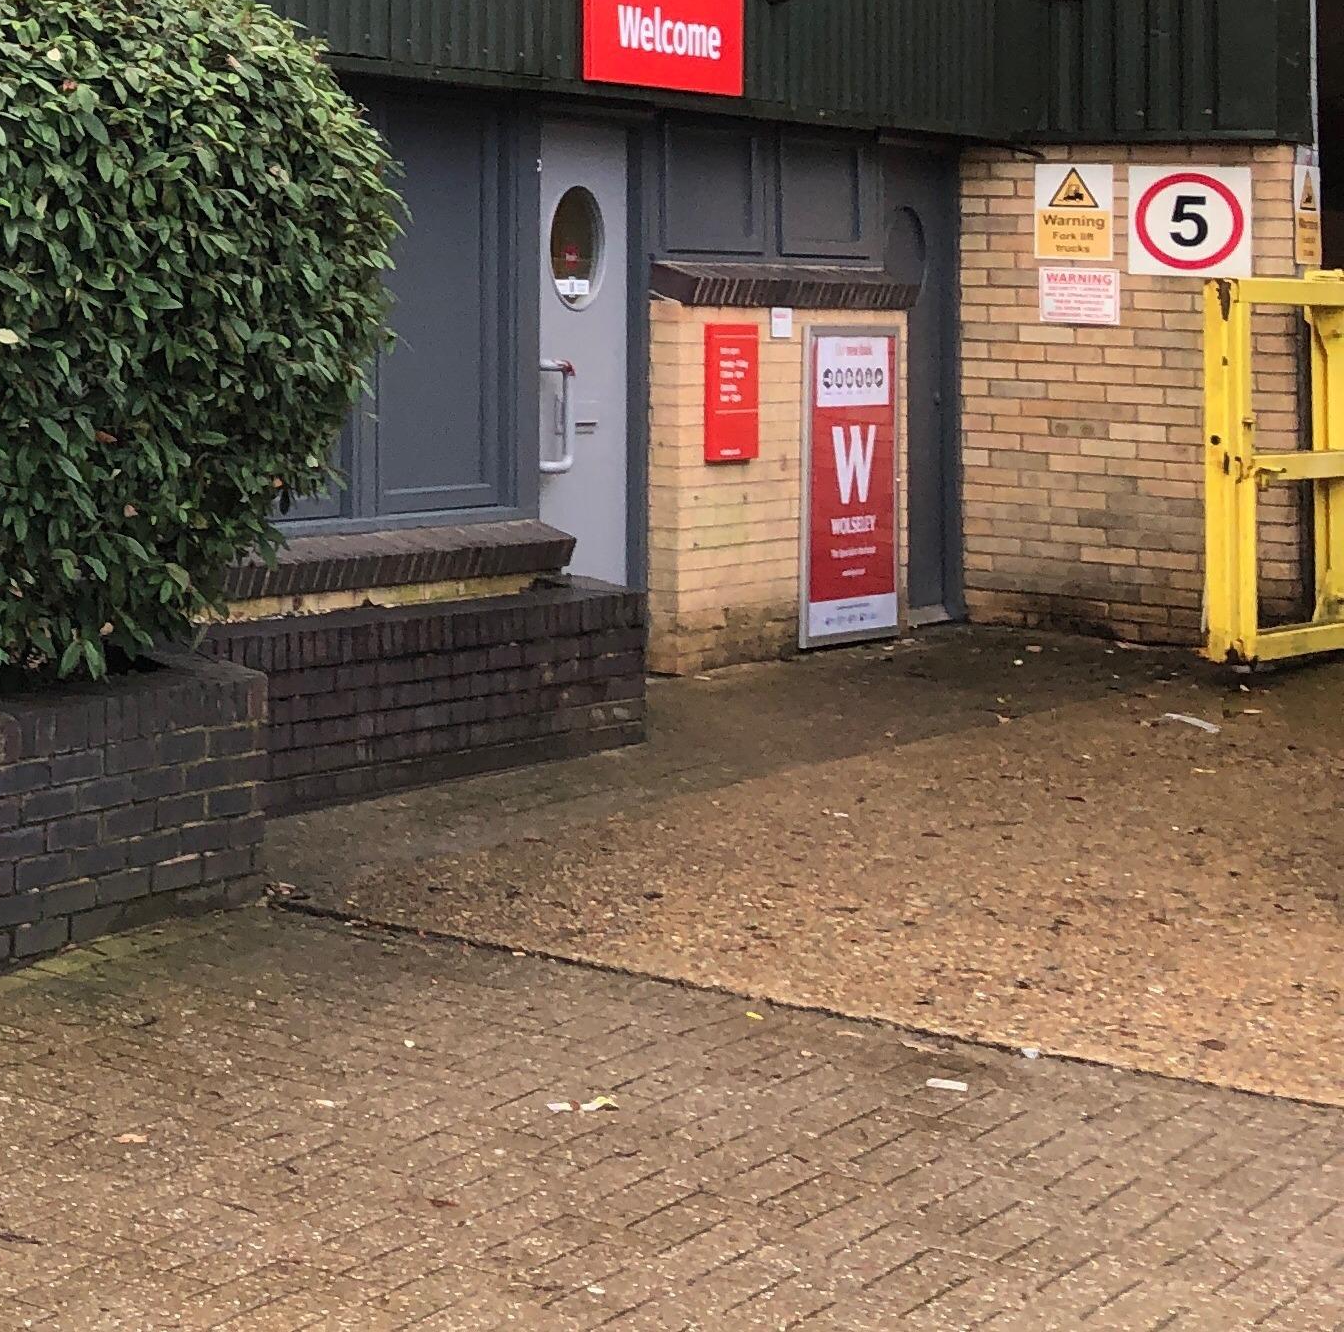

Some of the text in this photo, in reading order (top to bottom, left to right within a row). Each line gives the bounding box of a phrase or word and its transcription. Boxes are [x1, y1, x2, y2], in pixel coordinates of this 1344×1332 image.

[617, 4, 722, 60] Welcome
[1043, 214, 1105, 230] Warning
[1169, 195, 1209, 247] 5
[1052, 231, 1094, 241] Fork lift
[1055, 244, 1090, 253] trucks
[1046, 273, 1112, 285] WARNING
[831, 424, 877, 505] W
